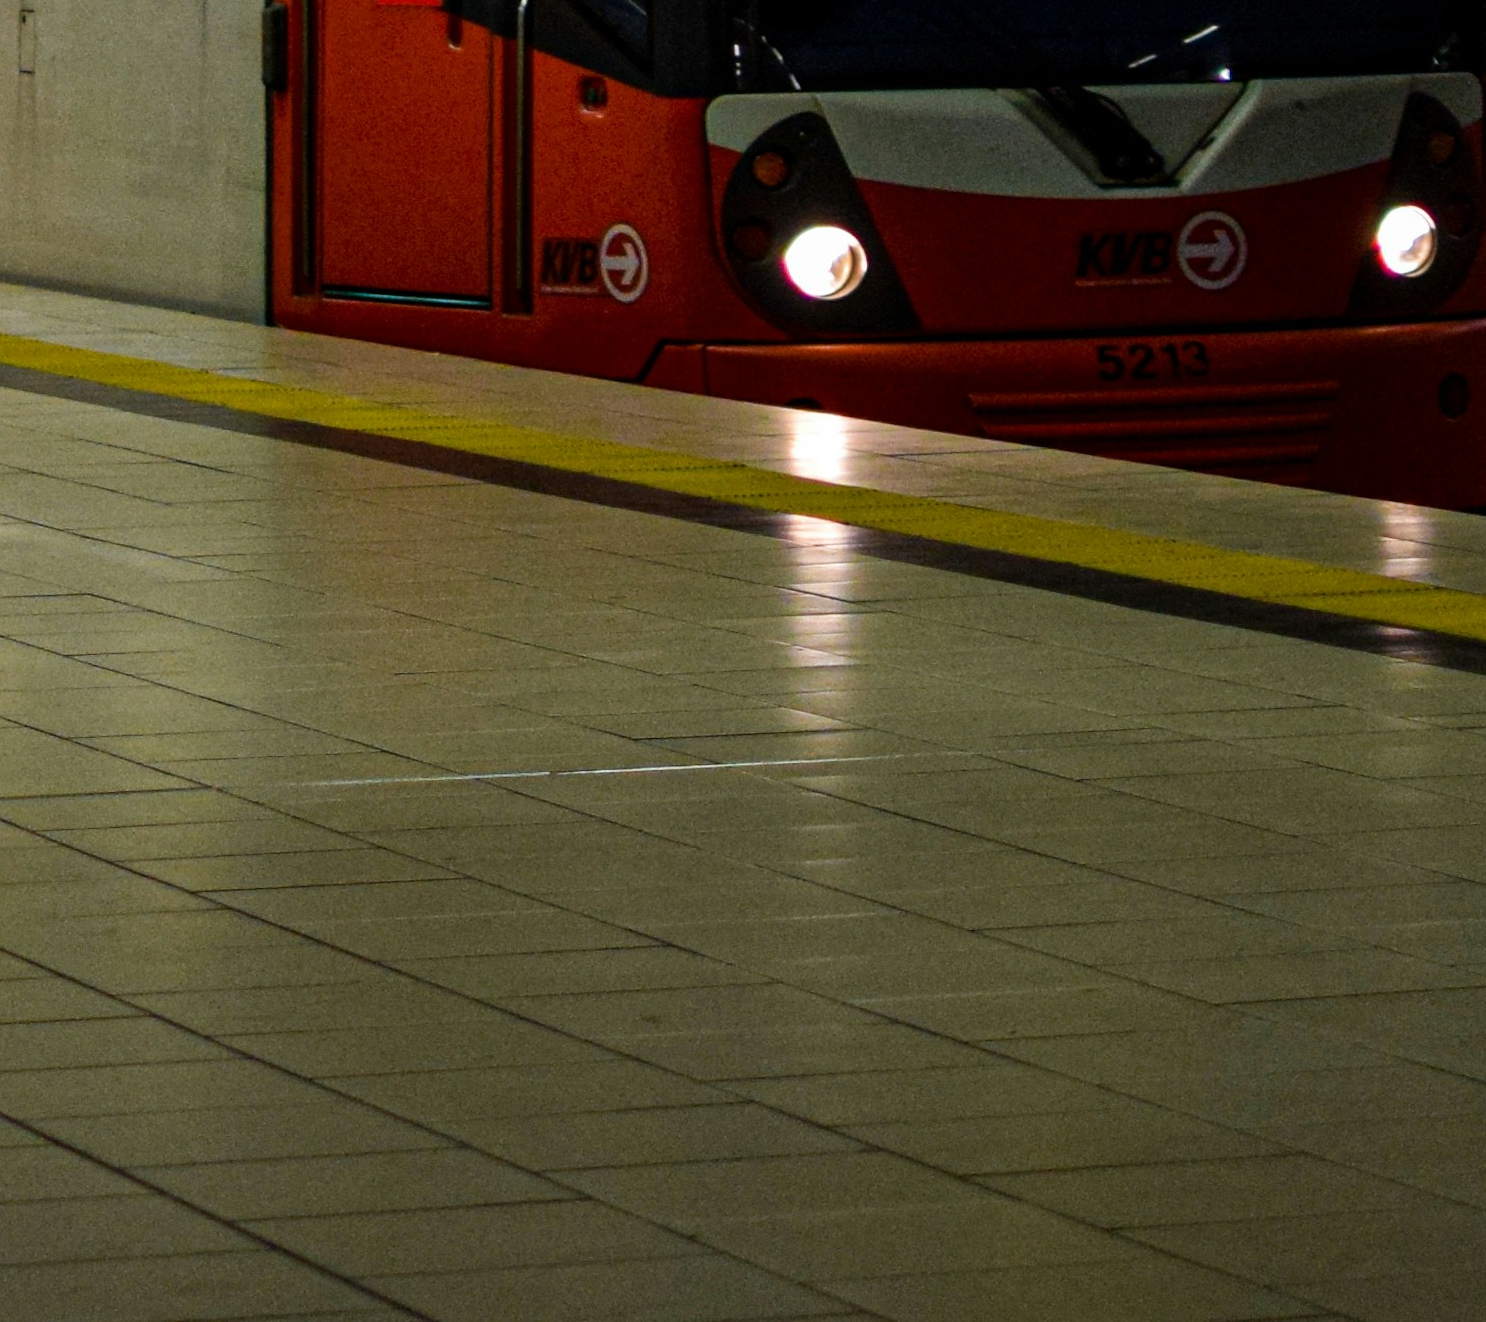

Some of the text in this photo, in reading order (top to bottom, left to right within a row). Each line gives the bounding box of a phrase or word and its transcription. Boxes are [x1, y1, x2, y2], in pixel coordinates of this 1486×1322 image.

[539, 239, 599, 287] KVB
[1077, 232, 1173, 276] KVB
[1097, 340, 1213, 382] 5213
